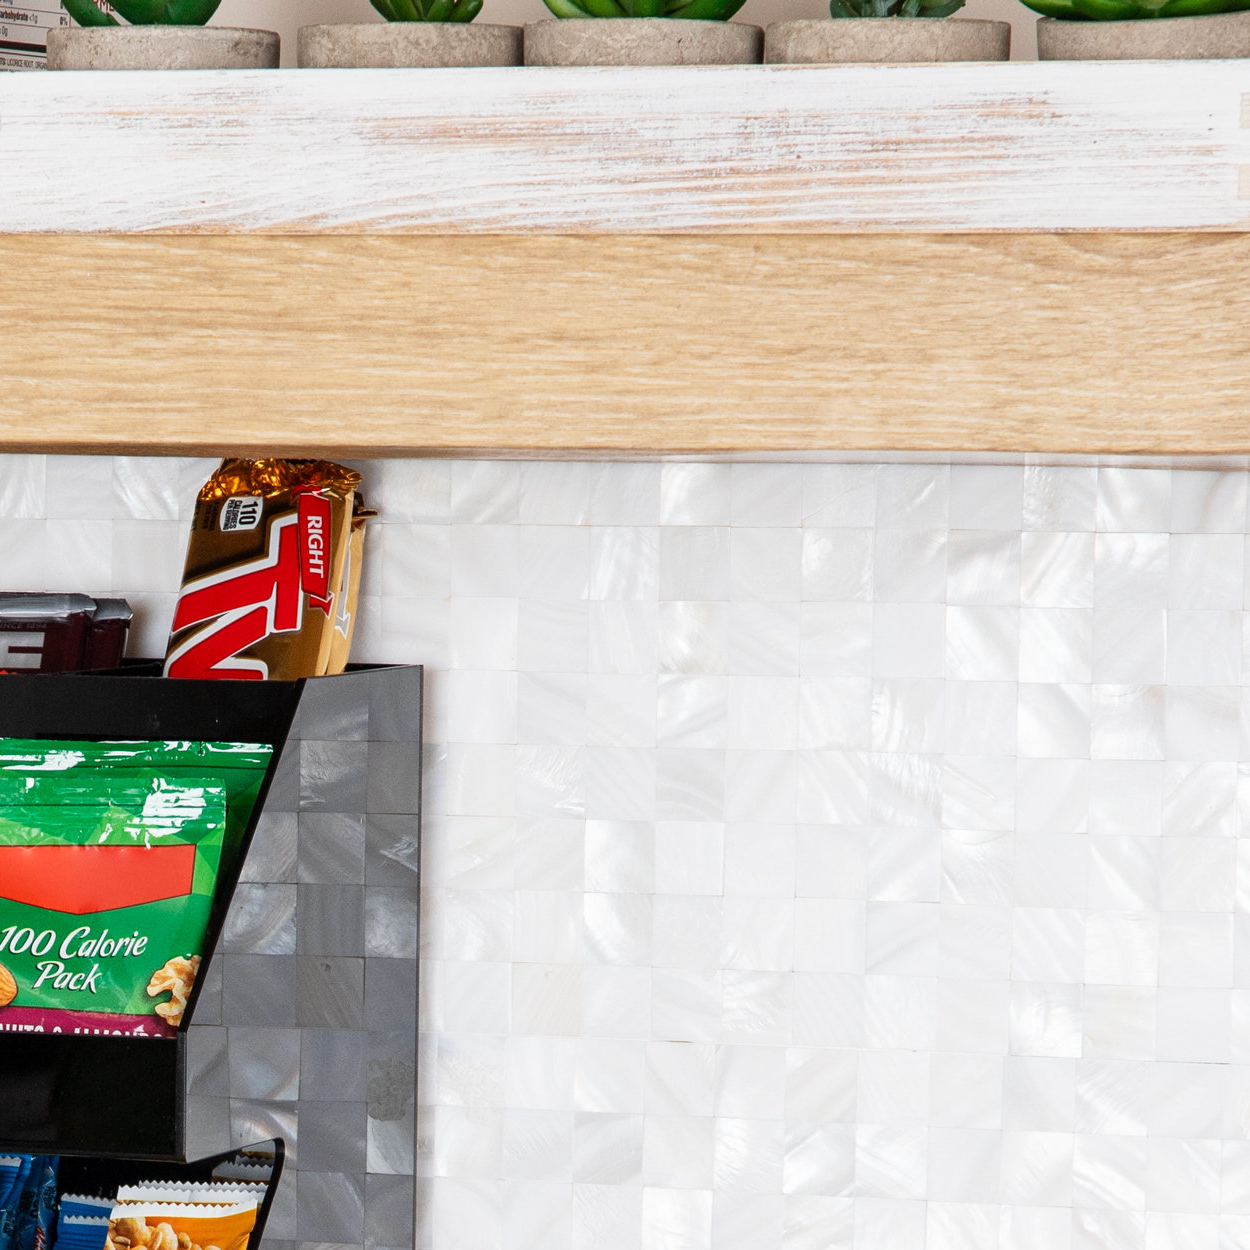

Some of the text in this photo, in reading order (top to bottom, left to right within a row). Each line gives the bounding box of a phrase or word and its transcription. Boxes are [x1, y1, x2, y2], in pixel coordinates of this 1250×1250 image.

[1, 27, 8, 37] 0g
[60, 16, 68, 26] 0%
[229, 500, 242, 529] CALORIES
[238, 500, 259, 526] 110
[307, 515, 324, 579] RIGHT
[59, 926, 148, 960] Calorie
[33, 960, 103, 994] Pack
